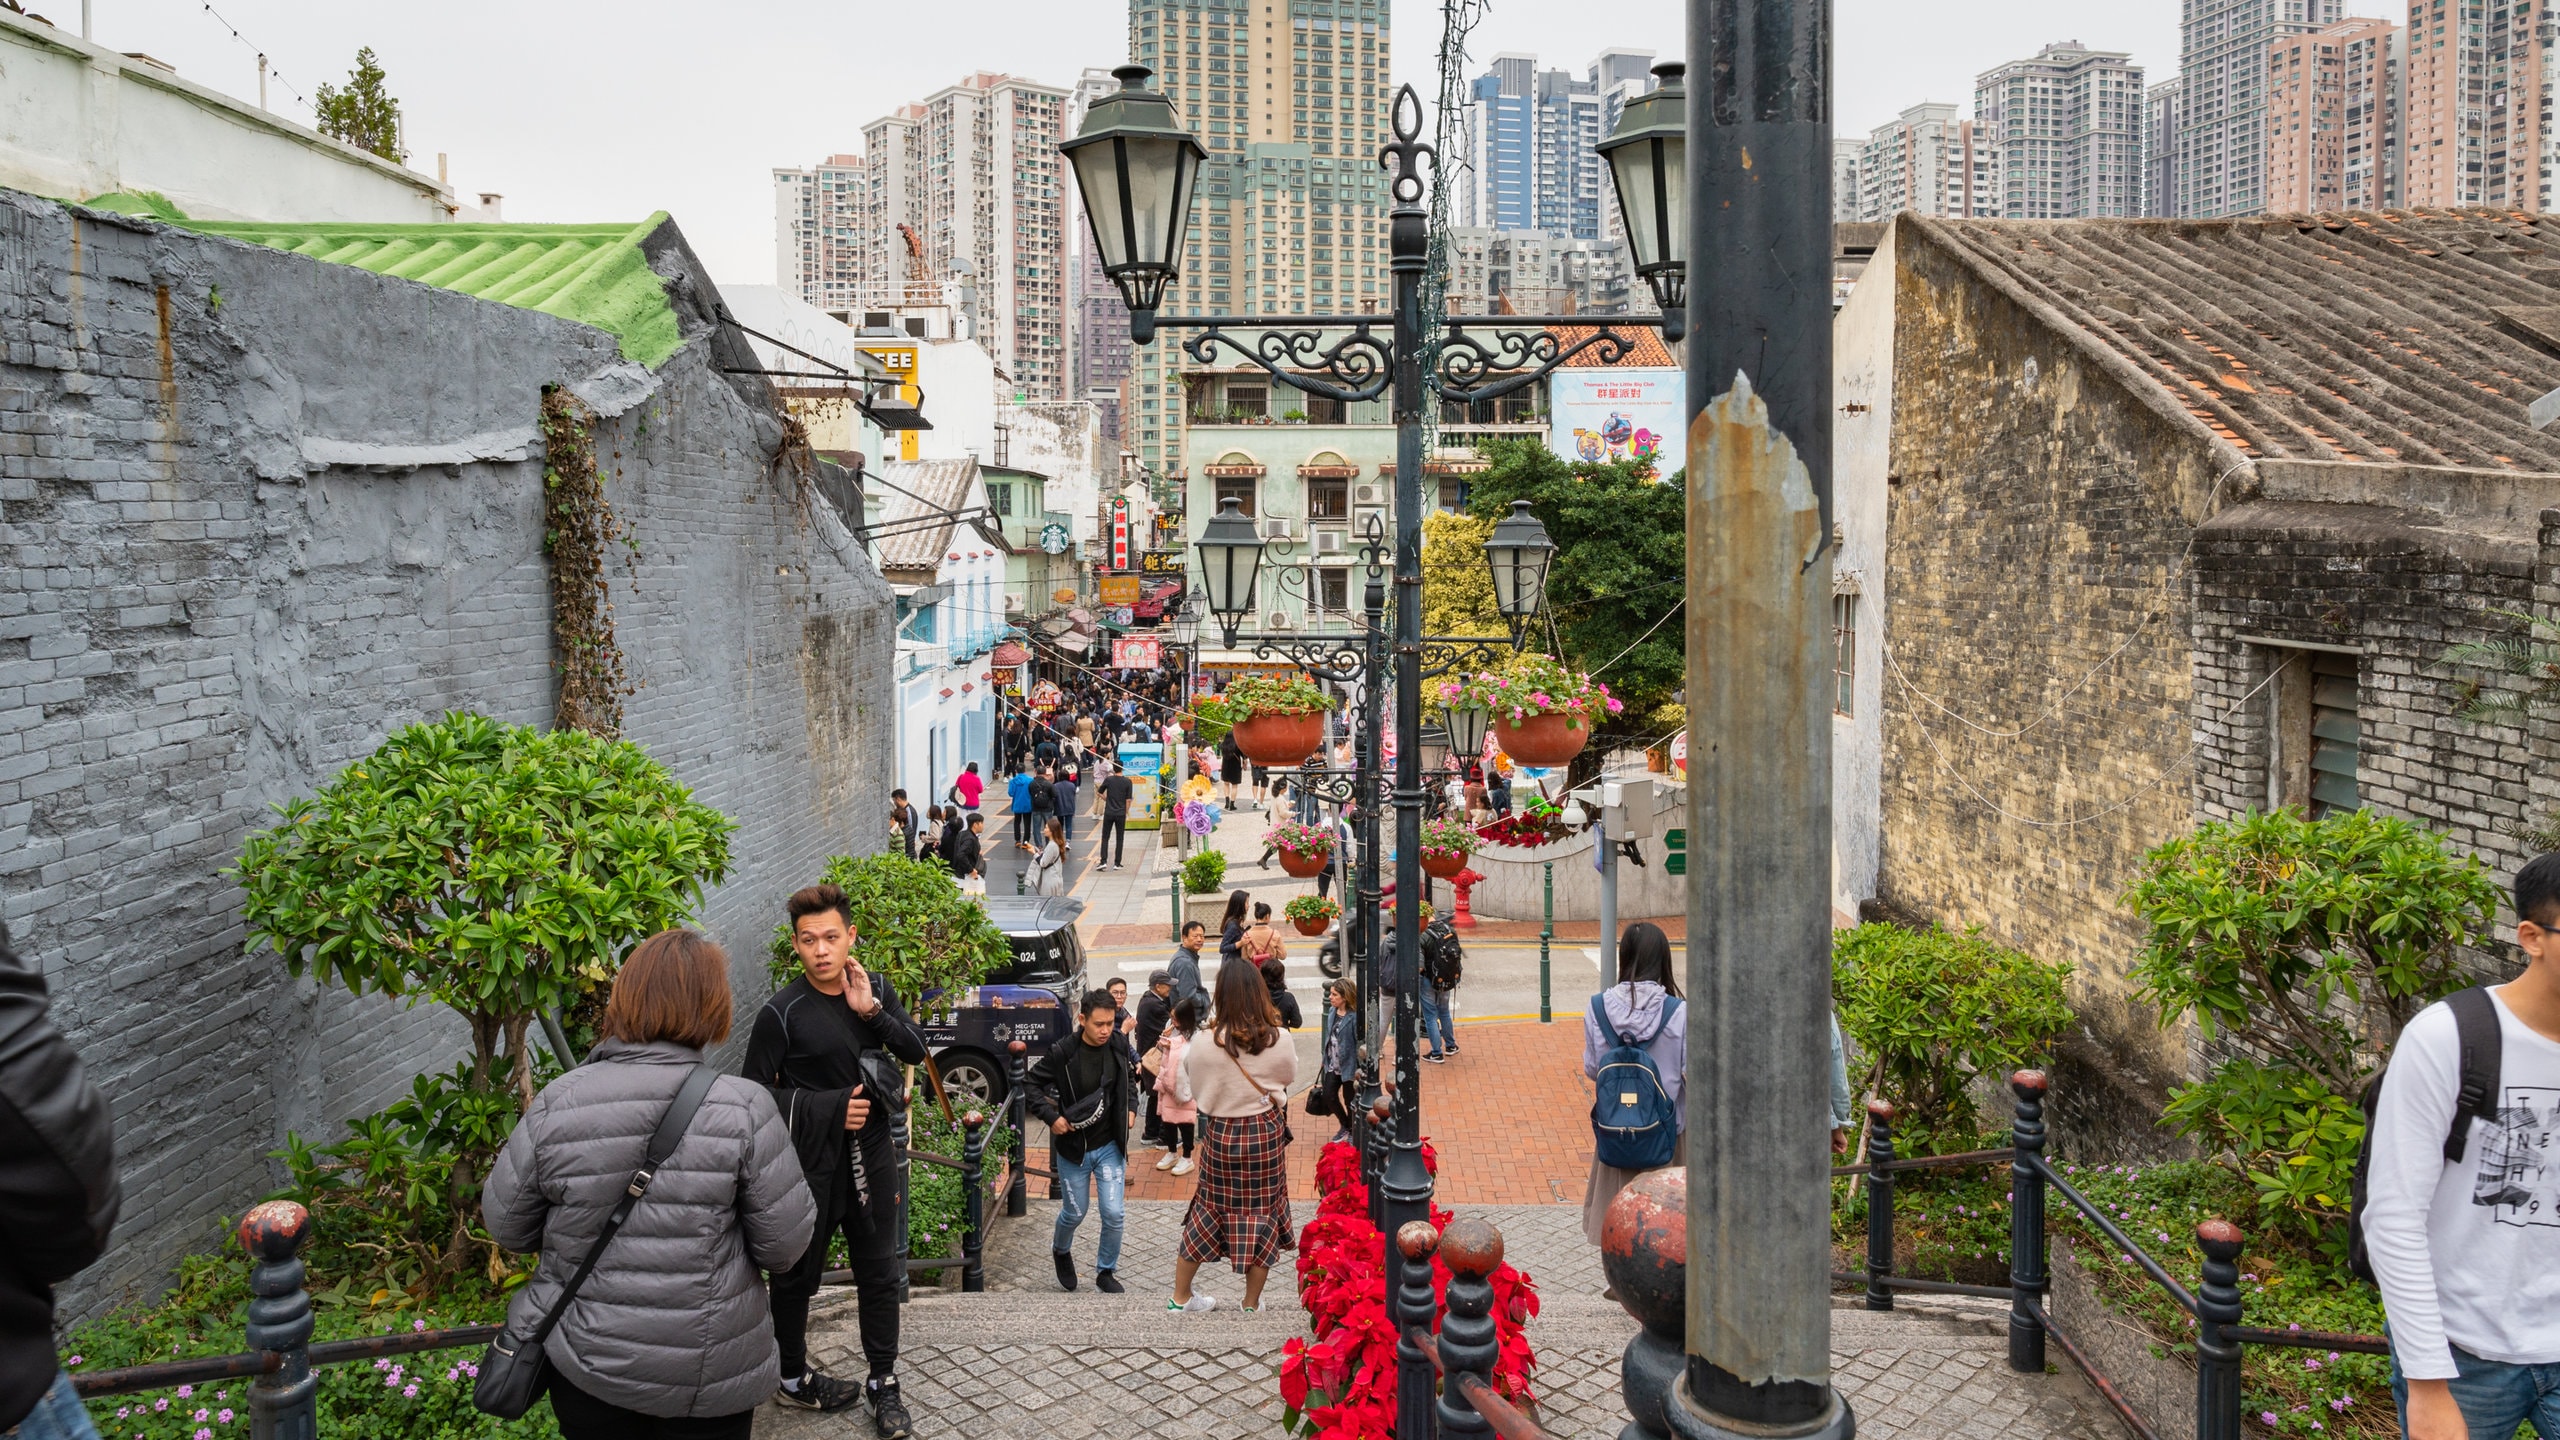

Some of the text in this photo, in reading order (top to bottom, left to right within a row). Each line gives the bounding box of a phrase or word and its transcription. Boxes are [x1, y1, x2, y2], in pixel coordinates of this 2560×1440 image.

[1597, 388, 1641, 399] 群星派對
[1020, 951, 1036, 962] 024
[1049, 947, 1060, 959] 024
[933, 1033, 956, 1041] Choice
